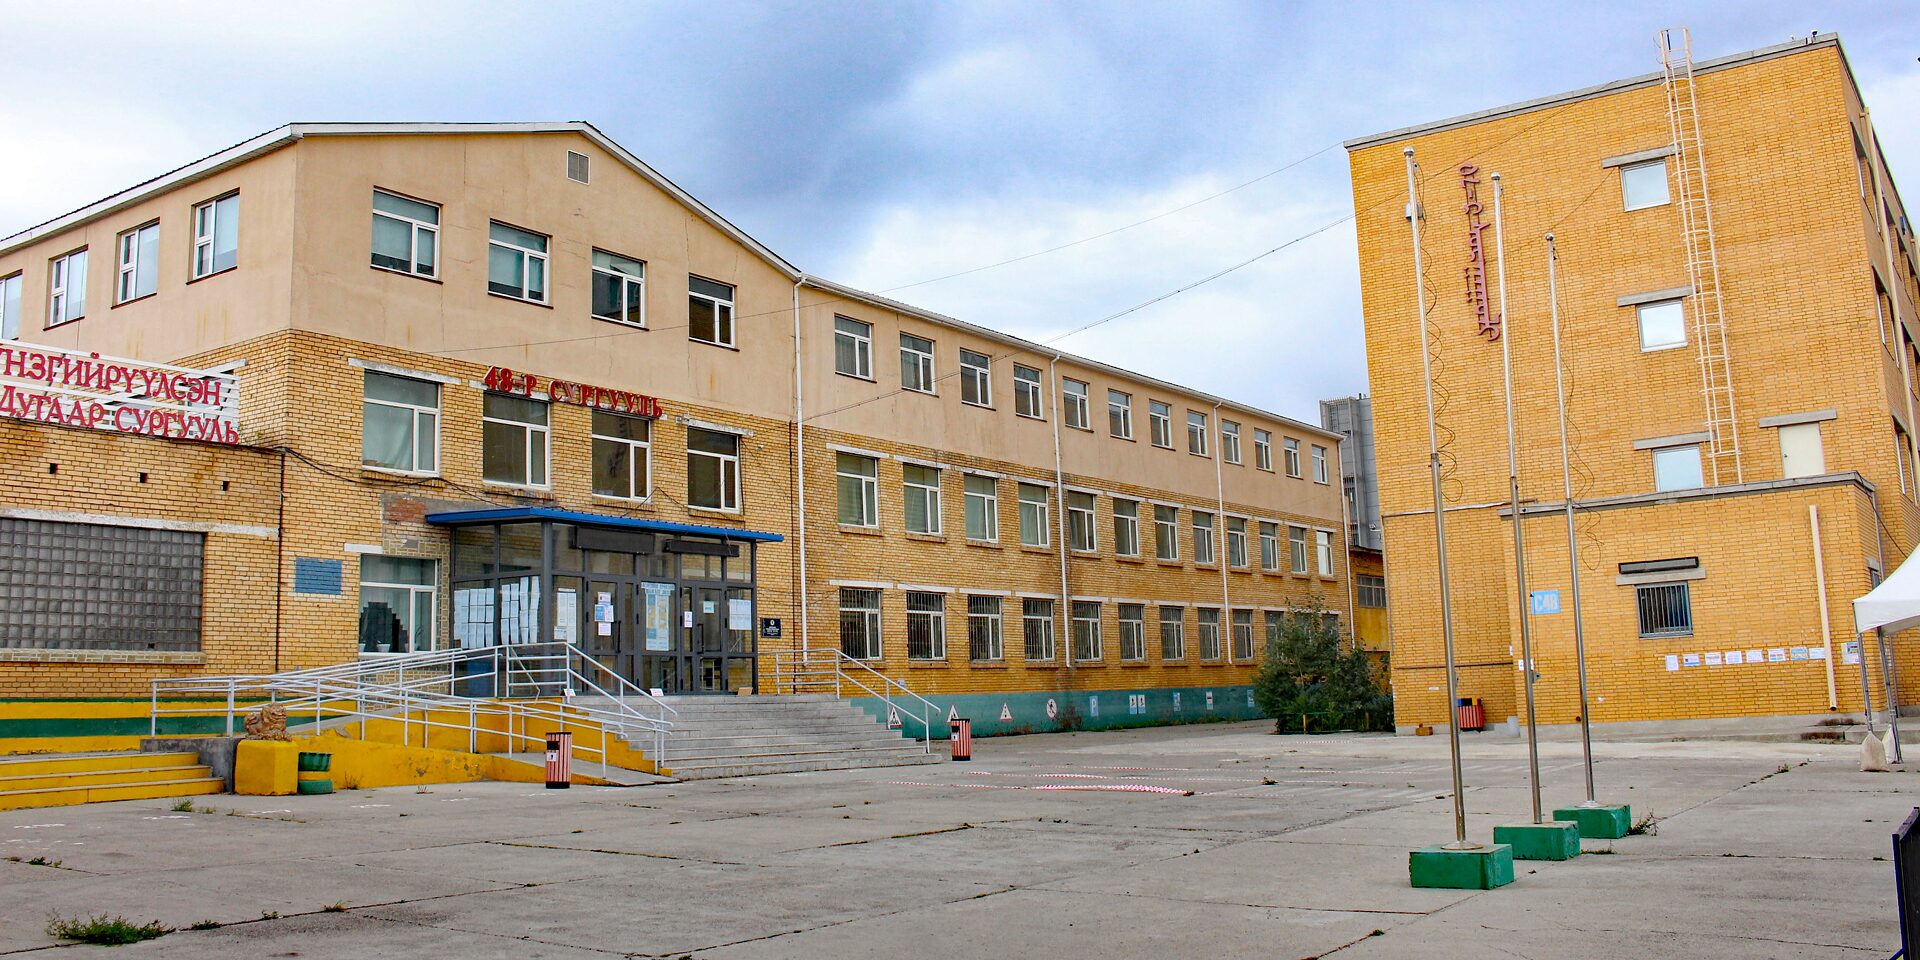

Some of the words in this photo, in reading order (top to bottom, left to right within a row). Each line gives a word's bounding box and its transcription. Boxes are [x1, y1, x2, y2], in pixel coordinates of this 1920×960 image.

[0, 348, 220, 405] НЗГИЙРҮҮЛСЭН
[549, 379, 663, 418] СУРГУУЛЬ
[0, 385, 105, 428] ДУГААР
[115, 406, 239, 444] СУРГУУЛЬ
